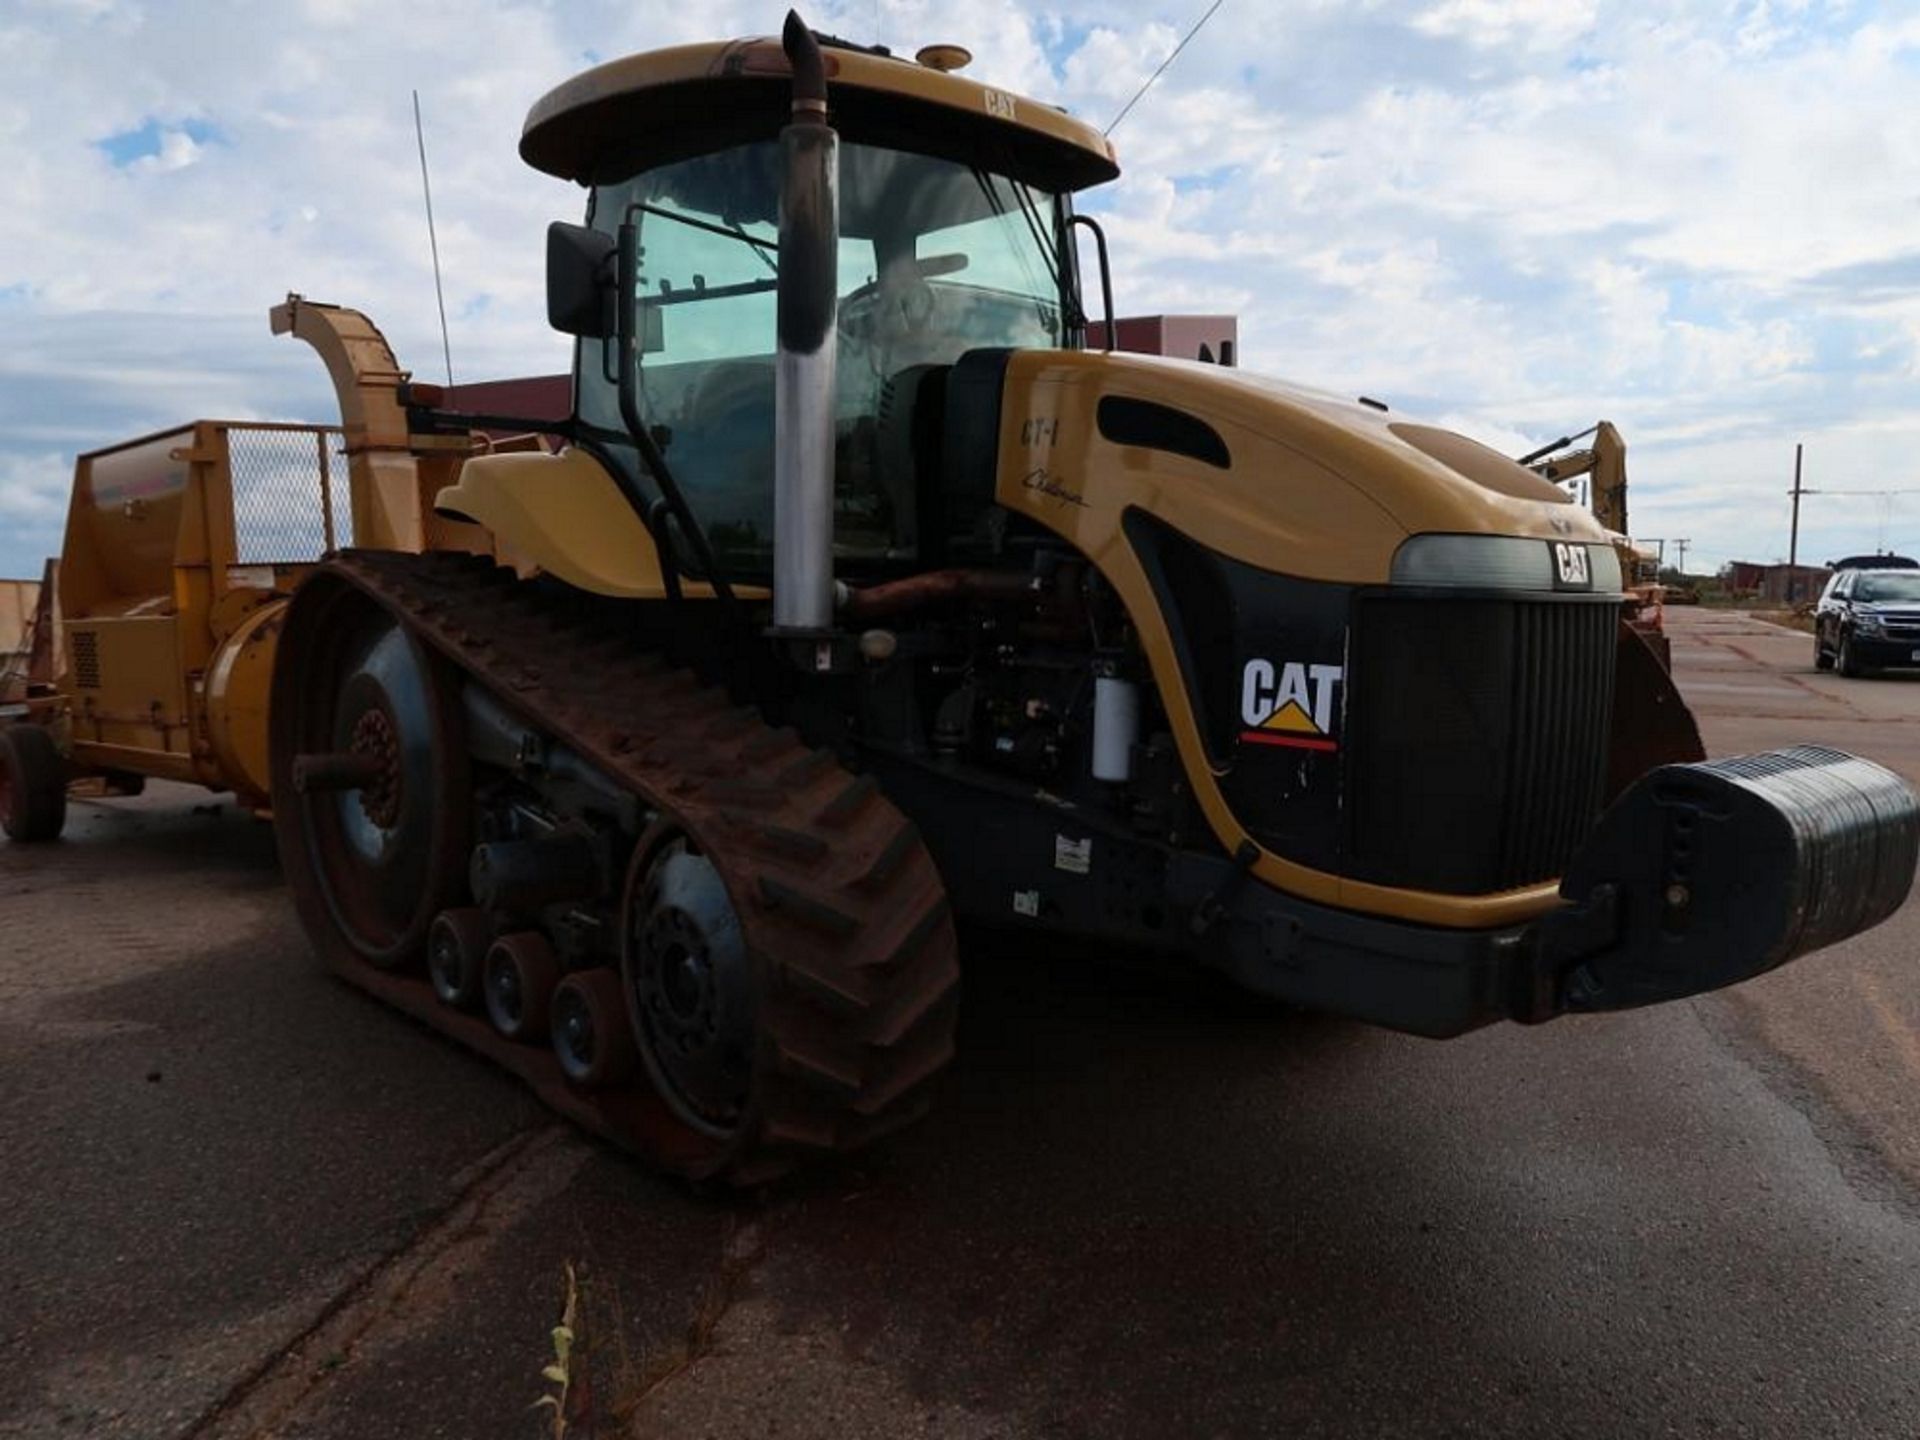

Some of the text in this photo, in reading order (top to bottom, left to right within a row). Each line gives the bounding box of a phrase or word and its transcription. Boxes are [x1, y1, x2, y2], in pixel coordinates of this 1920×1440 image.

[984, 89, 1016, 120] CAT
[1556, 543, 1588, 583] CAT
[1242, 658, 1343, 734] CAT
